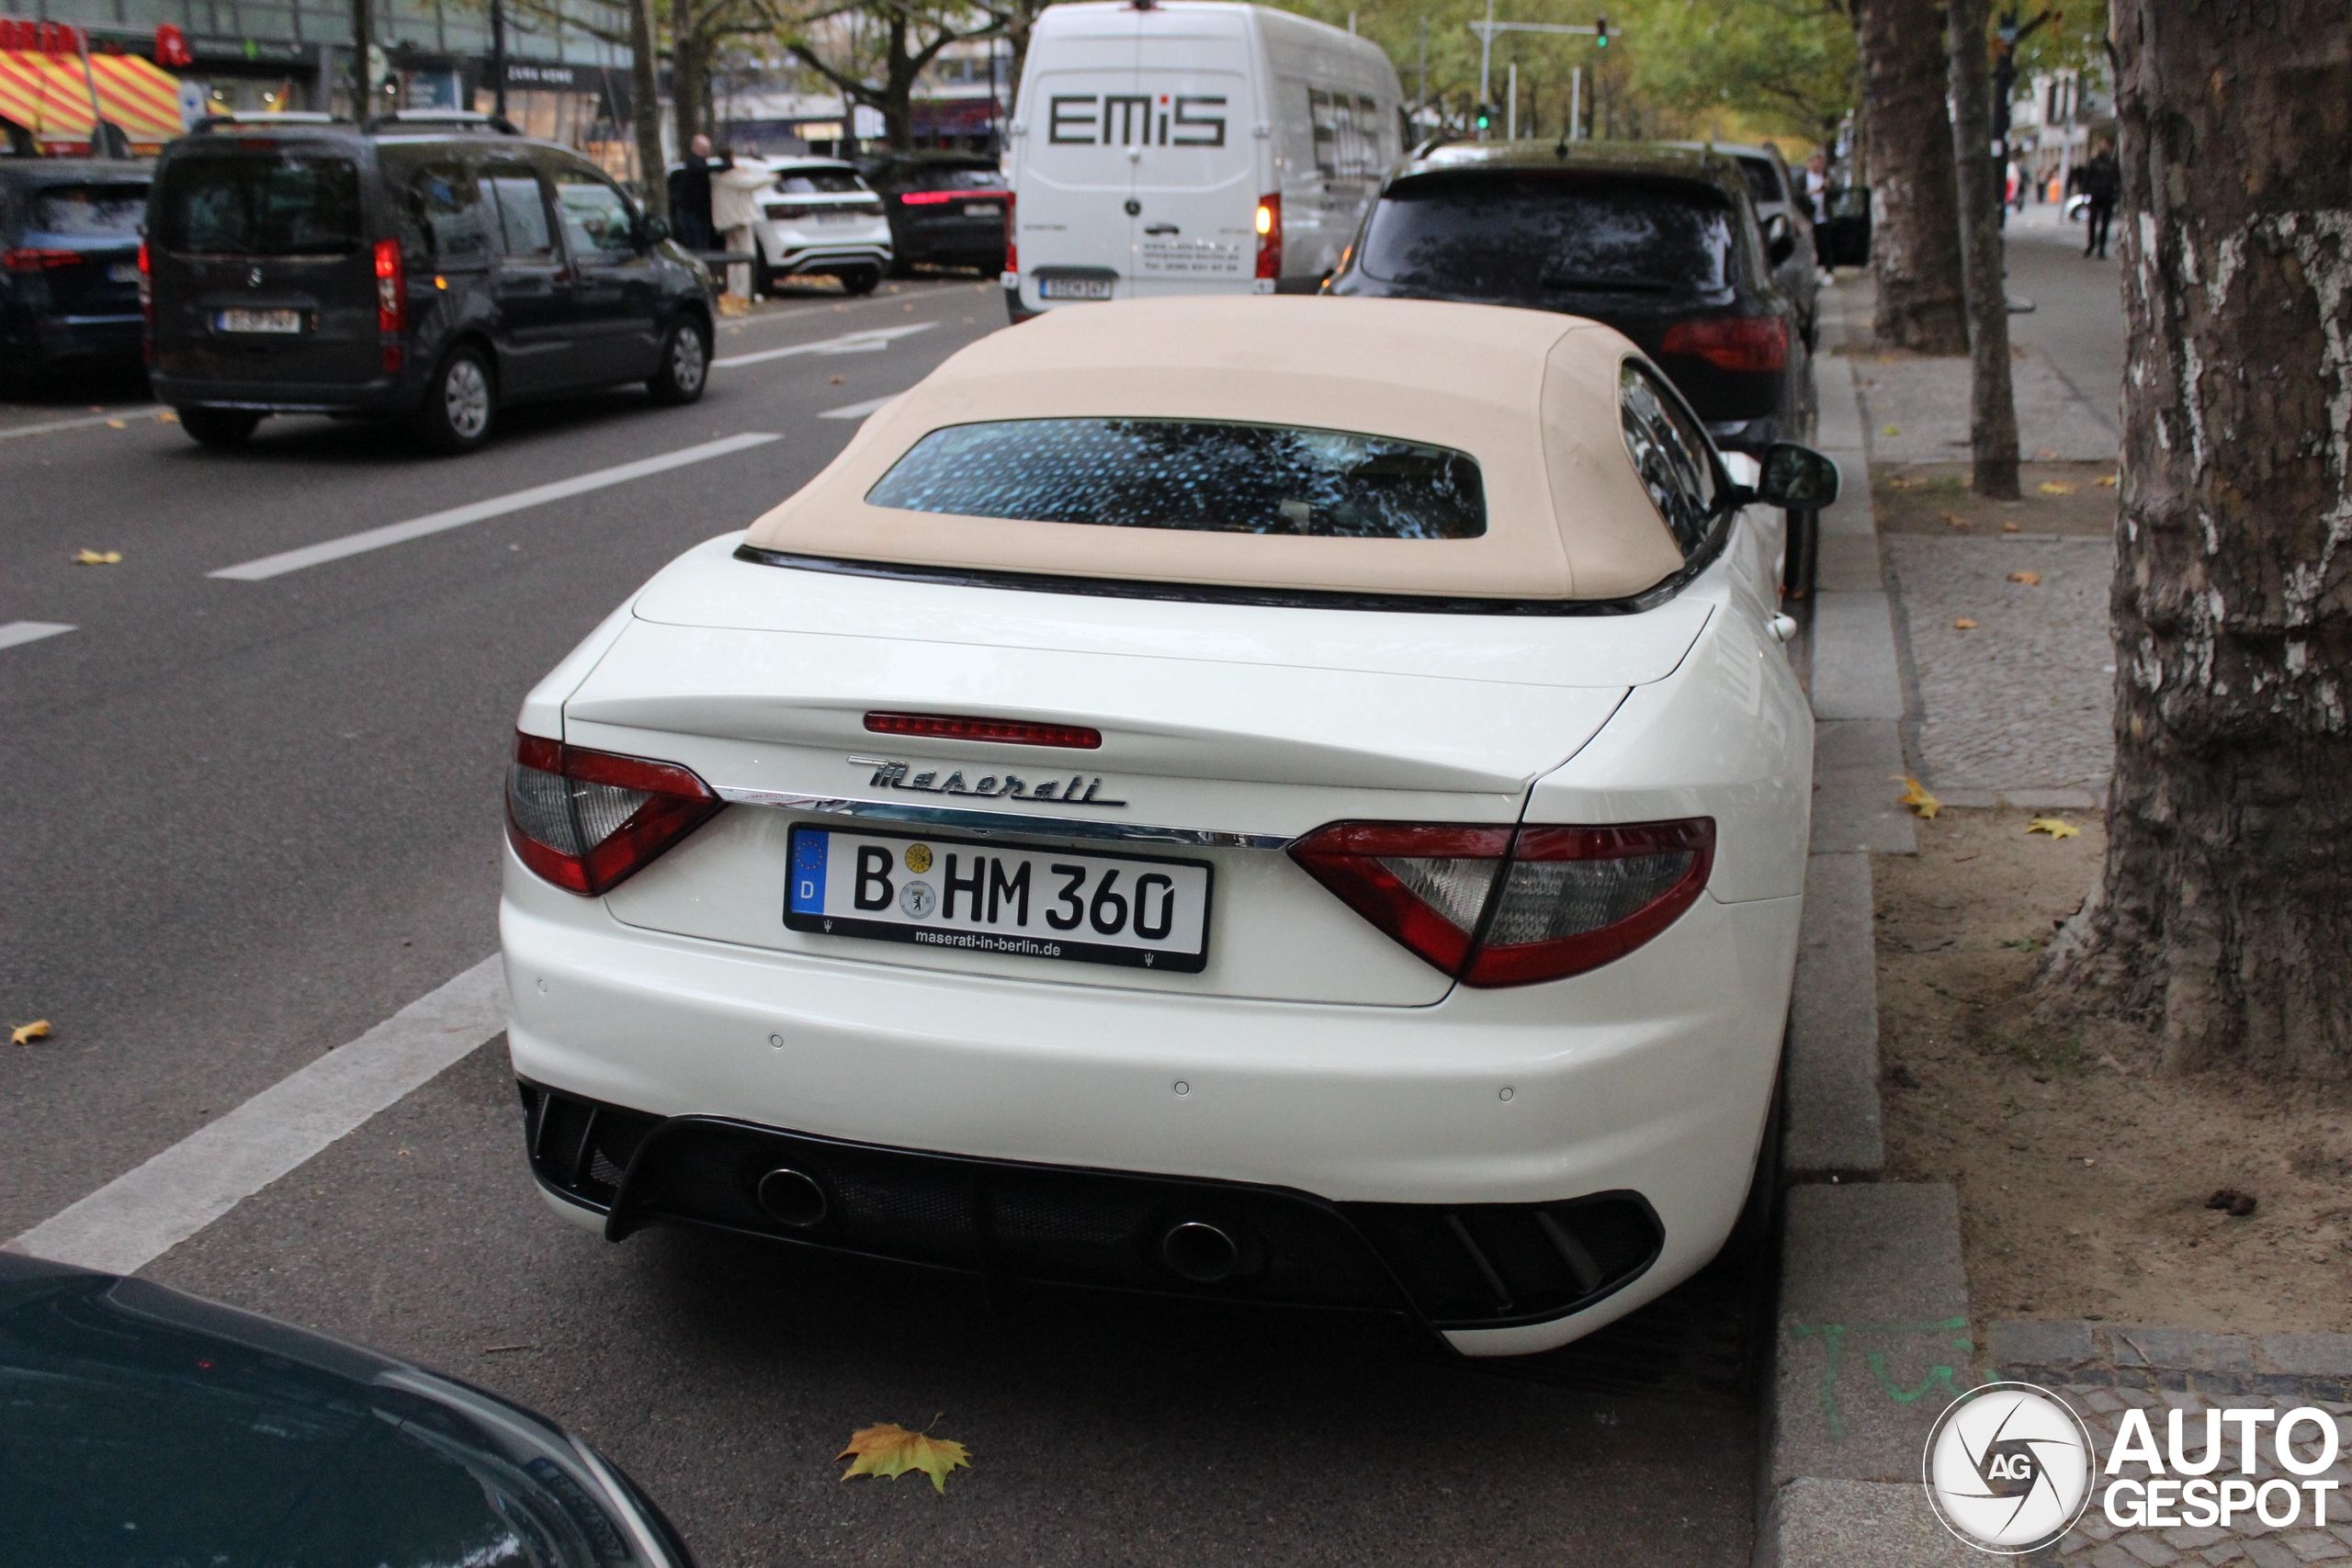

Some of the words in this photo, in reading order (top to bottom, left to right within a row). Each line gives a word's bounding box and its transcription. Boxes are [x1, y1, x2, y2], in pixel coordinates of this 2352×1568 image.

[846, 755, 1126, 807] Maserati
[800, 880, 814, 899] D
[854, 845, 894, 911] B
[942, 853, 1032, 927] HM
[1046, 863, 1175, 940] 360
[915, 930, 1061, 957] maserati-in-berlin.de
